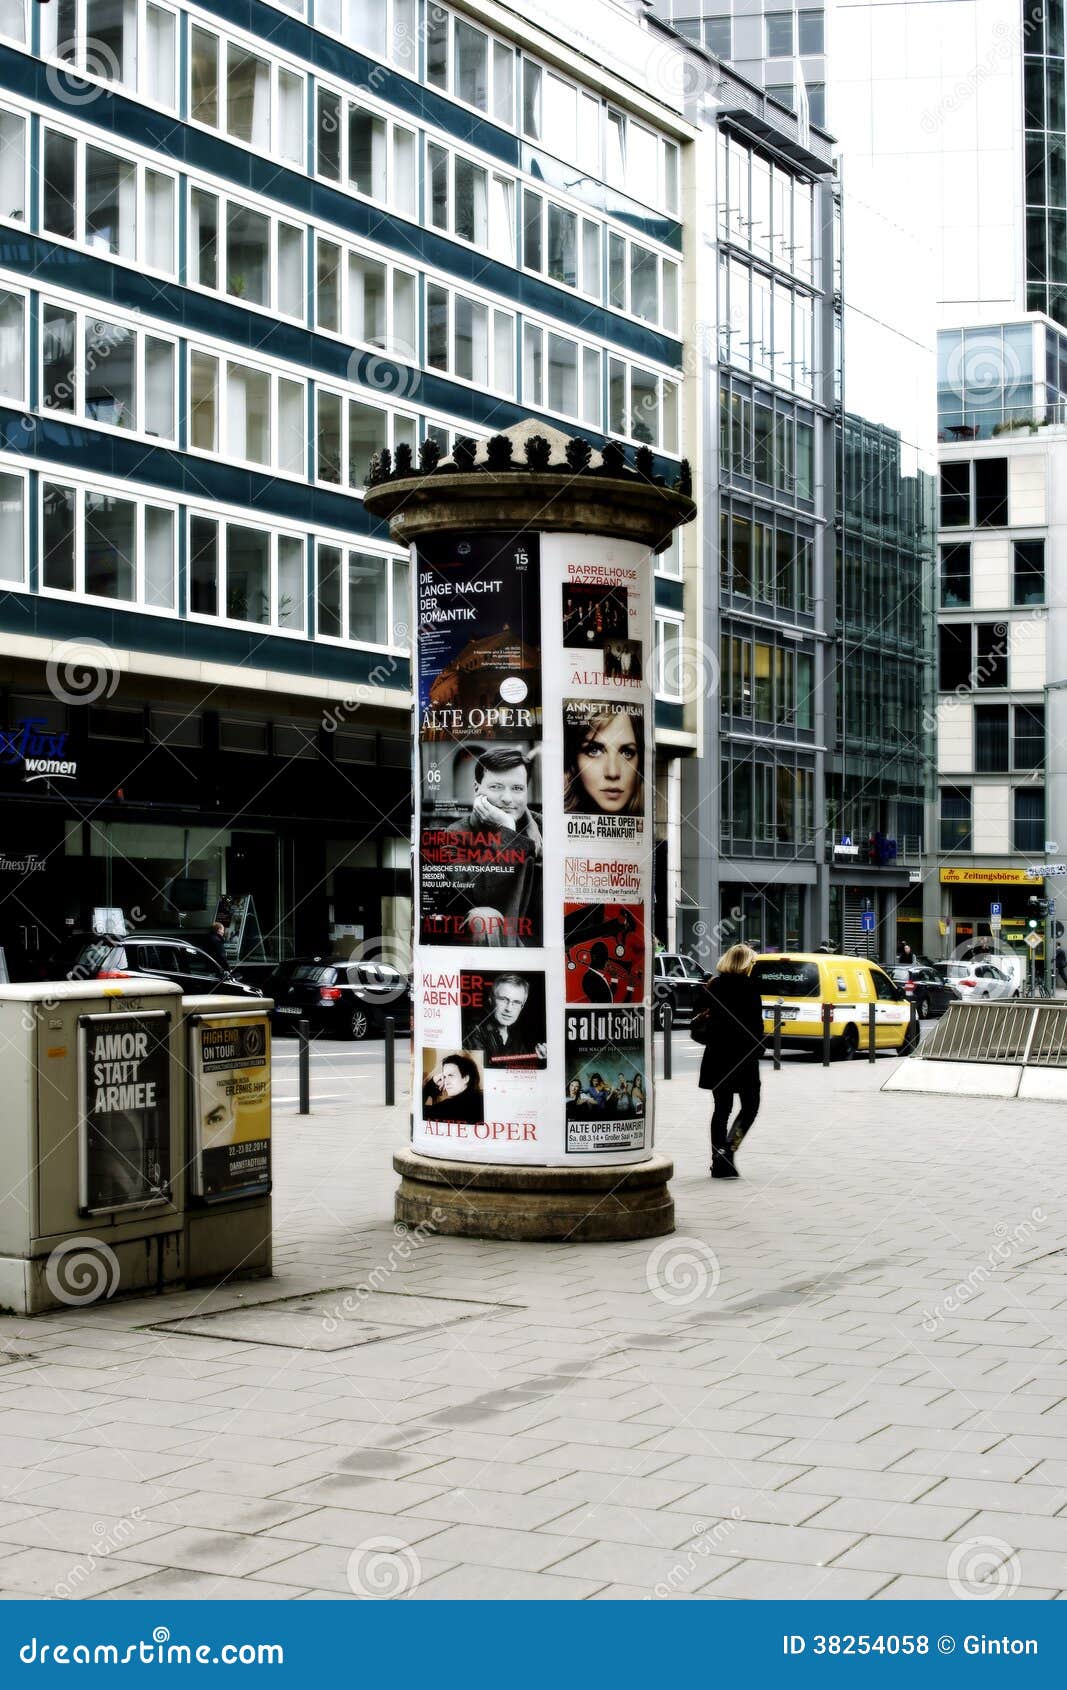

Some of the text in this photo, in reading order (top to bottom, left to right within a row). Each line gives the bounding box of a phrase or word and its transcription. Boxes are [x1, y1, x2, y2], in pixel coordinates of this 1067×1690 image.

[513, 553, 529, 565] 15
[420, 572, 433, 585] DIE
[567, 564, 637, 580] BARRELHOUSE
[420, 581, 503, 597] LANGE NACHT
[420, 598, 438, 611] DER
[420, 608, 477, 624] ROMANTIK
[571, 671, 610, 686] ALTE
[566, 702, 643, 717] ANNETT LOUISAN
[422, 708, 533, 729] ALTE OPER
[25, 758, 77, 775] women
[427, 770, 441, 783] 06
[597, 816, 636, 827] ALTE OPER
[422, 831, 503, 847] CHRISTIAN
[597, 827, 636, 838] FRANKFURT
[421, 847, 527, 864] THIELEMANN
[422, 864, 515, 873] SÄCHSISCHE STAATSKAPELLE
[963, 872, 1020, 882] Zeitungsbörse
[423, 914, 533, 936] ALTE OPER
[422, 973, 494, 990] KLAVIER-
[423, 990, 483, 1007] ABENDE
[423, 1008, 441, 1018] 2014
[203, 1031, 222, 1044] HIGH
[94, 1032, 149, 1062] AMOR
[203, 1044, 235, 1060] ON TOUR
[94, 1060, 141, 1086] STATT
[94, 1082, 157, 1113] ARMEE
[424, 1118, 538, 1141] ALTE OPER
[570, 1121, 644, 1133] ALTE OPER FRANKFURT
